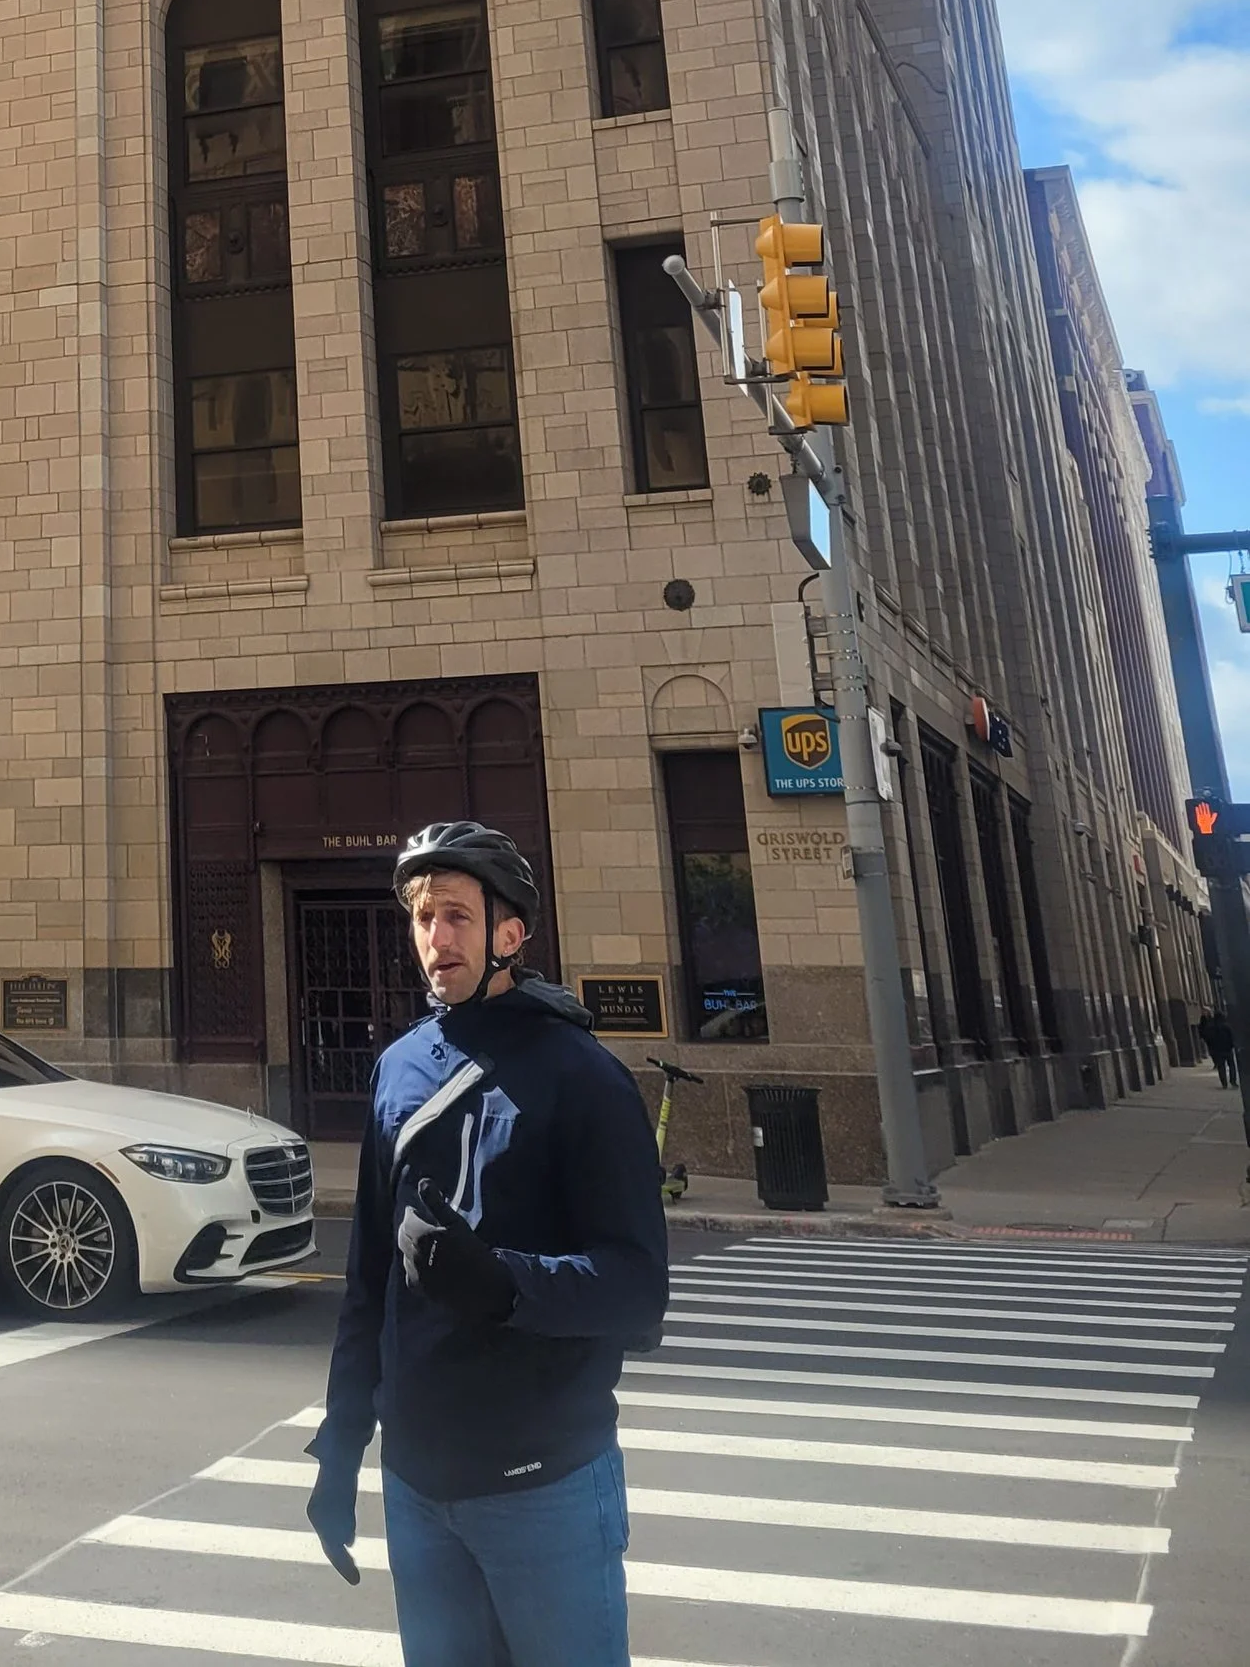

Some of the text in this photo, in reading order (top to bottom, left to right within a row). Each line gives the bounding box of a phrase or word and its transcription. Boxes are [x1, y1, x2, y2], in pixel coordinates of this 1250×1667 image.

[786, 731, 828, 761] ups
[775, 777, 846, 789] THE UPS STOR
[322, 835, 398, 848] THE BUHL BAR
[757, 832, 845, 846] GRISWOLD
[772, 847, 832, 861] STREET
[598, 985, 645, 994] LEWIS
[600, 1005, 646, 1014] MUNDAY
